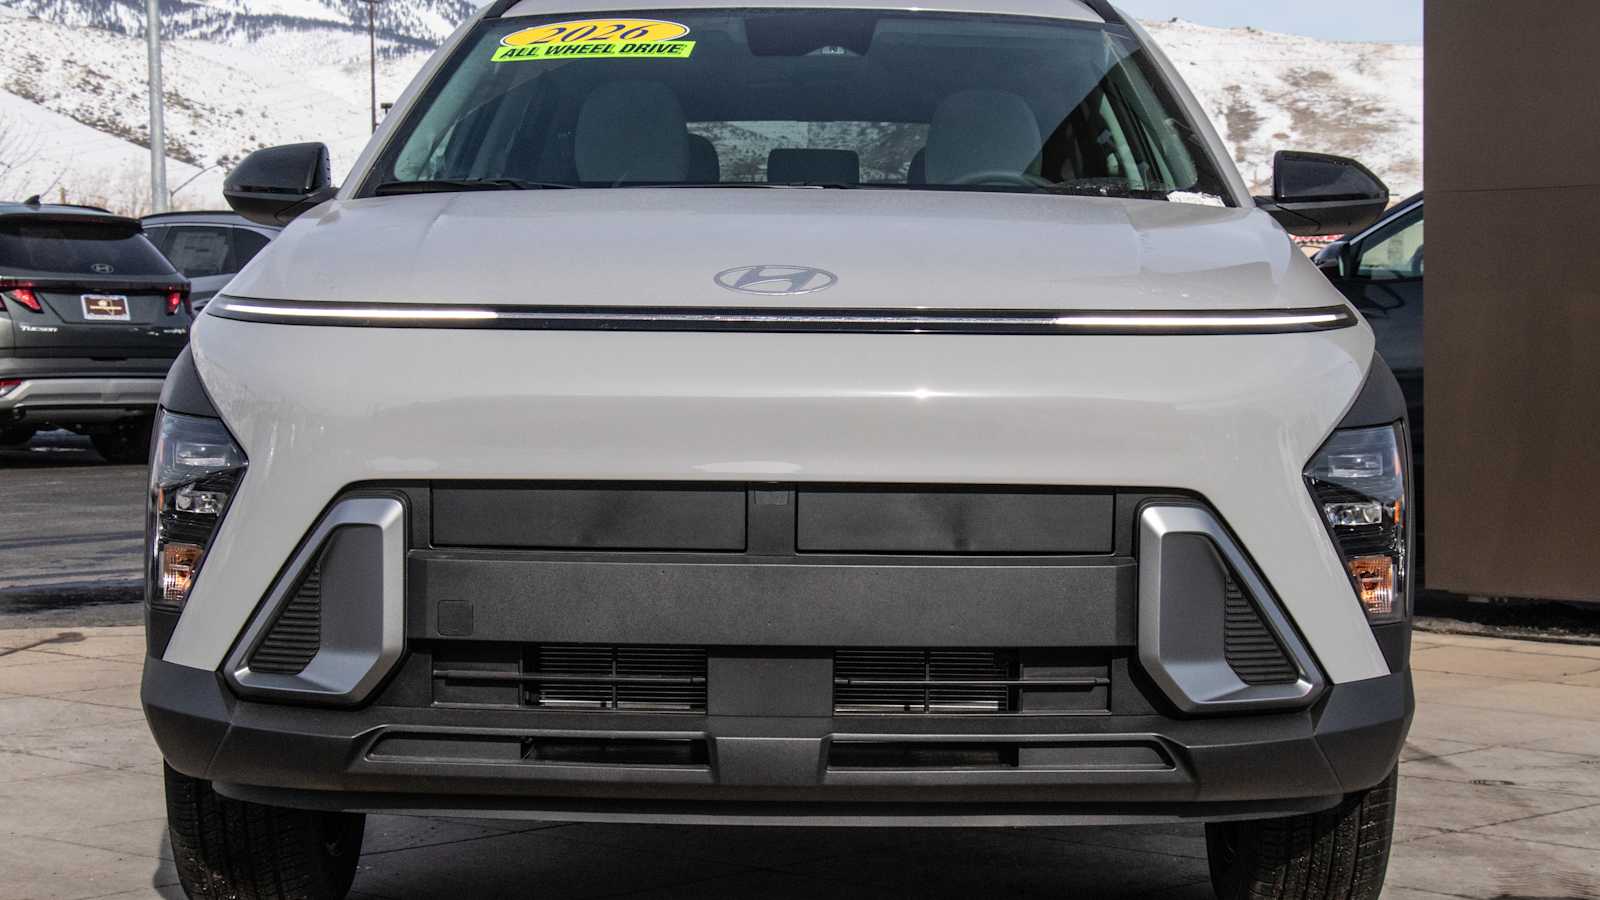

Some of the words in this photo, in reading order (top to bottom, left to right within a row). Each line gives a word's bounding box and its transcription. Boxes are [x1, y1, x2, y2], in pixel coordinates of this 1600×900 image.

[528, 24, 658, 44] 2026
[500, 47, 538, 58] ALL
[544, 44, 613, 55] WHEEL
[619, 43, 682, 54] DRIVE
